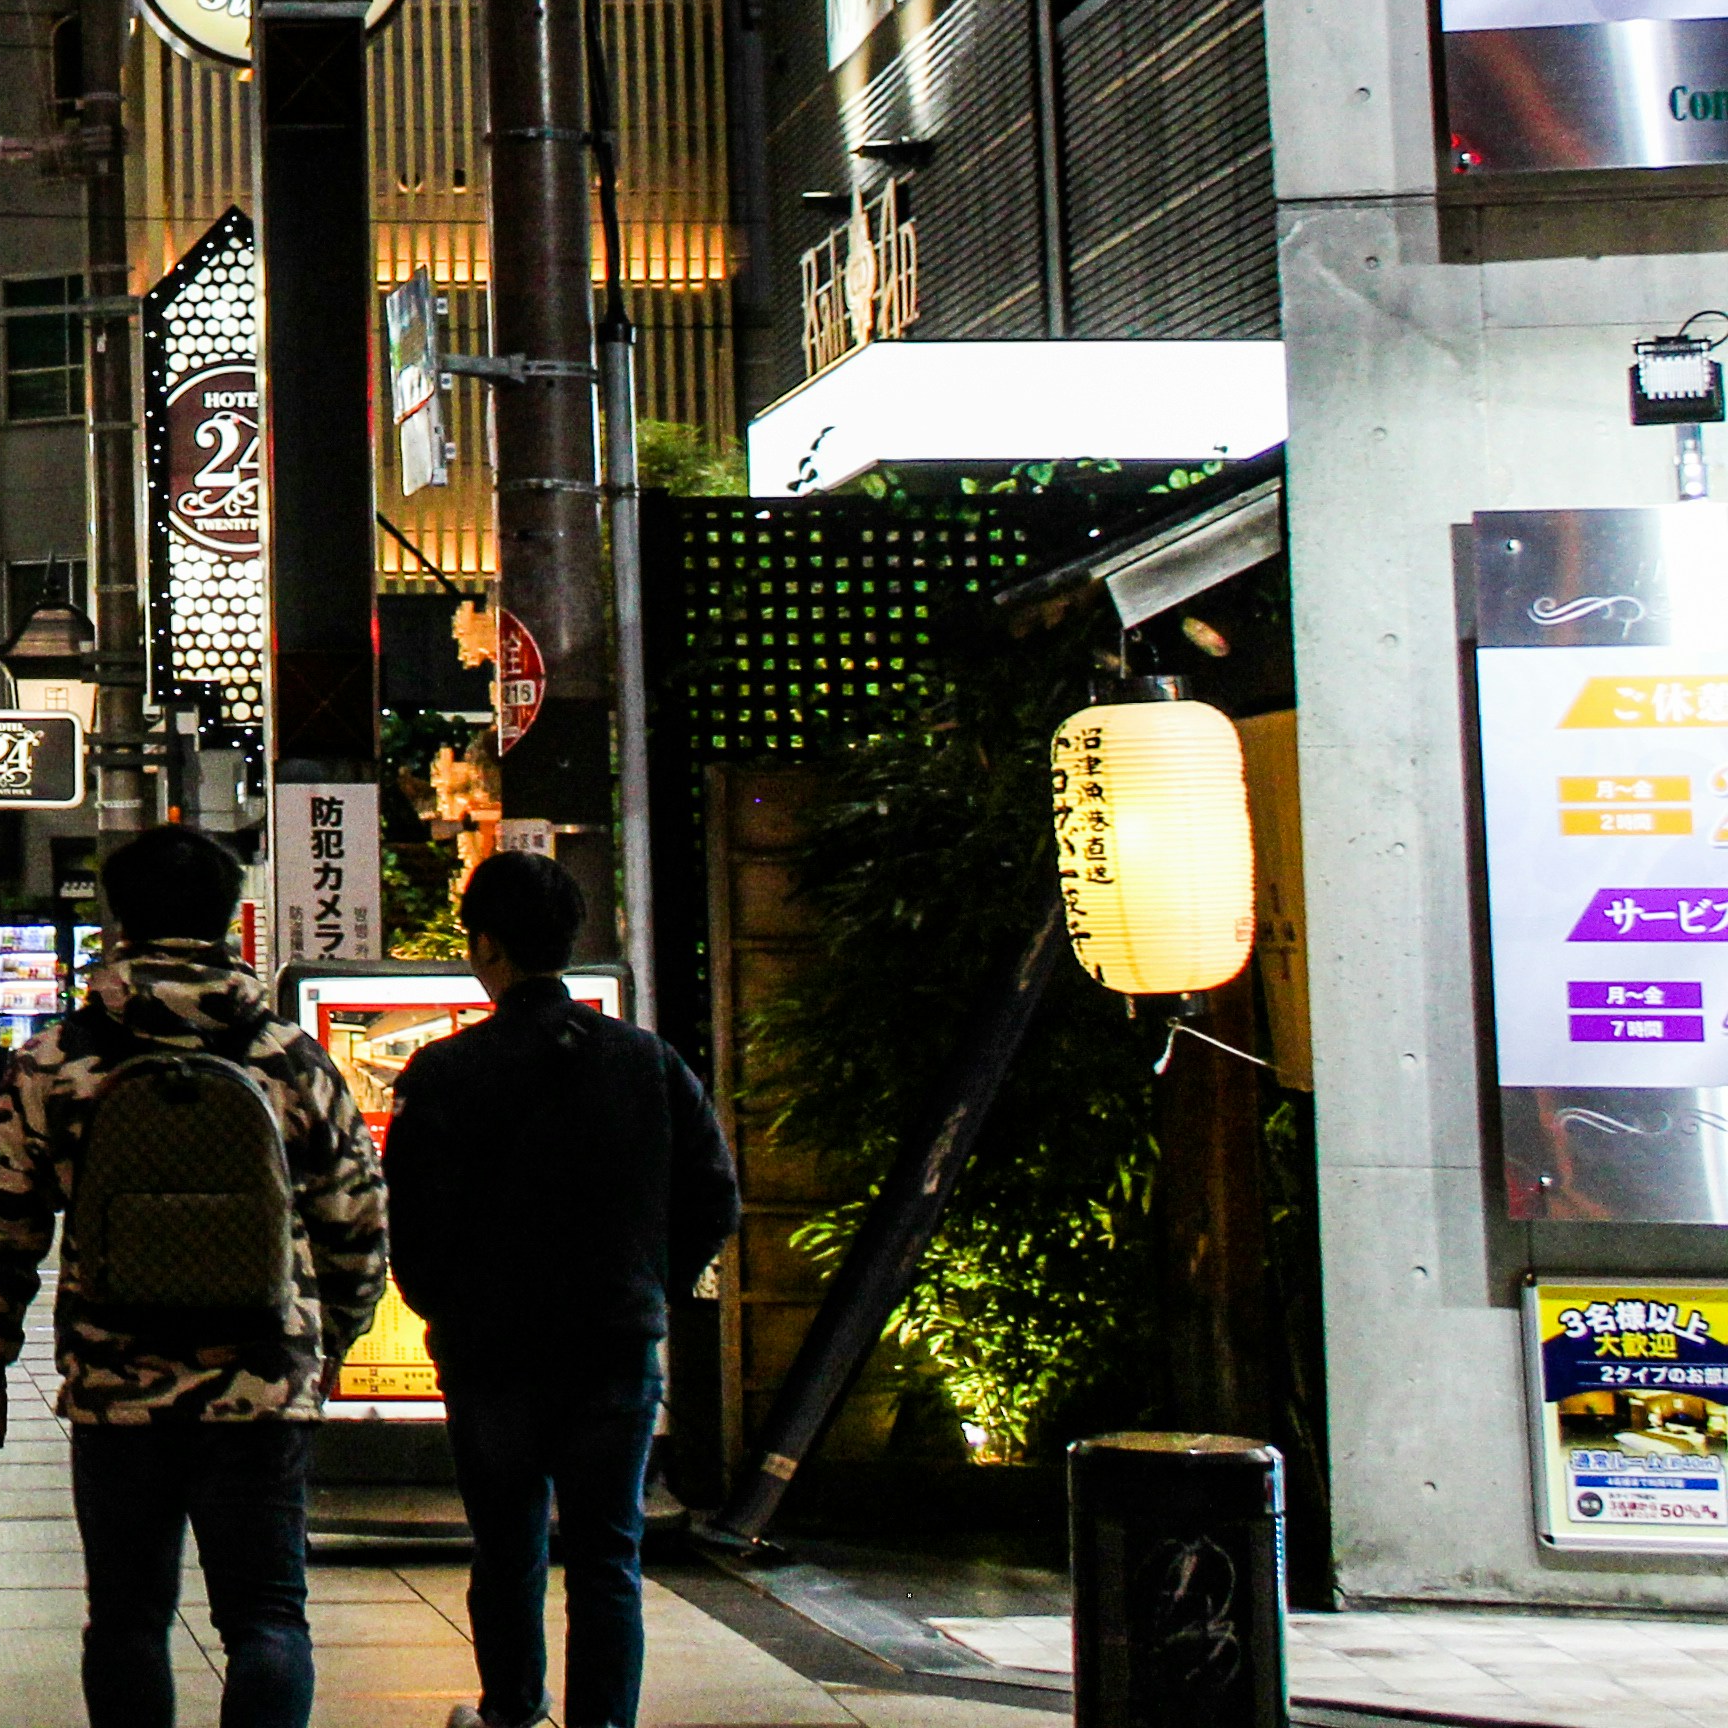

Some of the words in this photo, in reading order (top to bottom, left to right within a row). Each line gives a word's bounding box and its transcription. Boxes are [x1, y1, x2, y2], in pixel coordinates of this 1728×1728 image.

[203, 391, 259, 409] HOTE
[309, 795, 346, 960] 防犯カメラ
[1558, 1298, 1711, 1346] 3名様以上
[1593, 1332, 1679, 1360] 大歓迎
